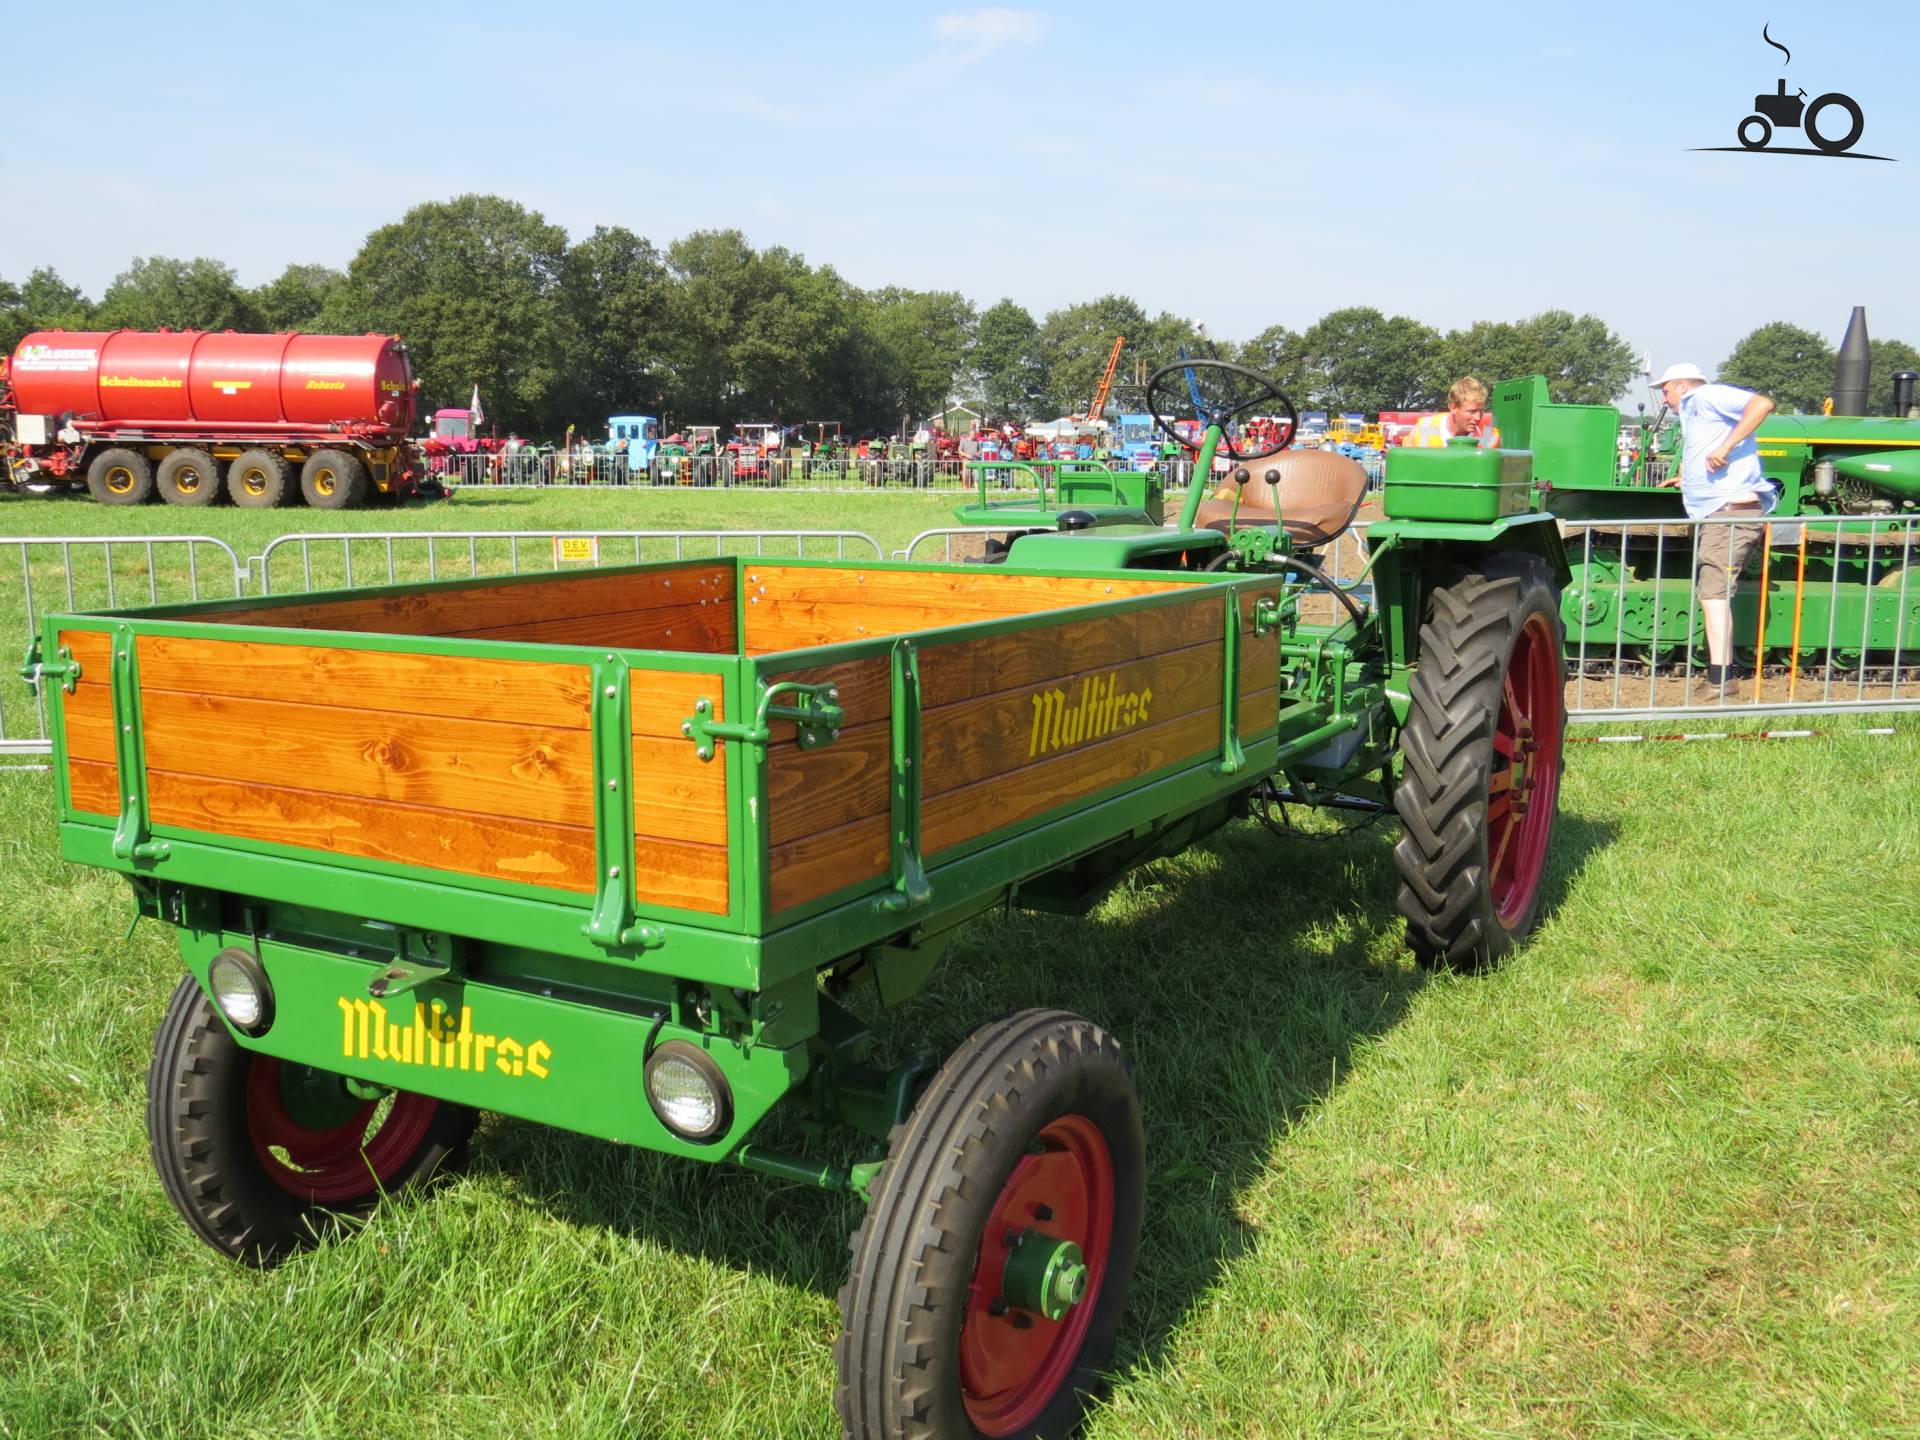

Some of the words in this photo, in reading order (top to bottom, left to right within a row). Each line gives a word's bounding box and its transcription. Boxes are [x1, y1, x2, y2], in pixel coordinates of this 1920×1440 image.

[100, 376, 183, 388] Schuitemaker
[1028, 672, 1153, 758] Multitrac
[338, 996, 552, 1079] Multitrac
